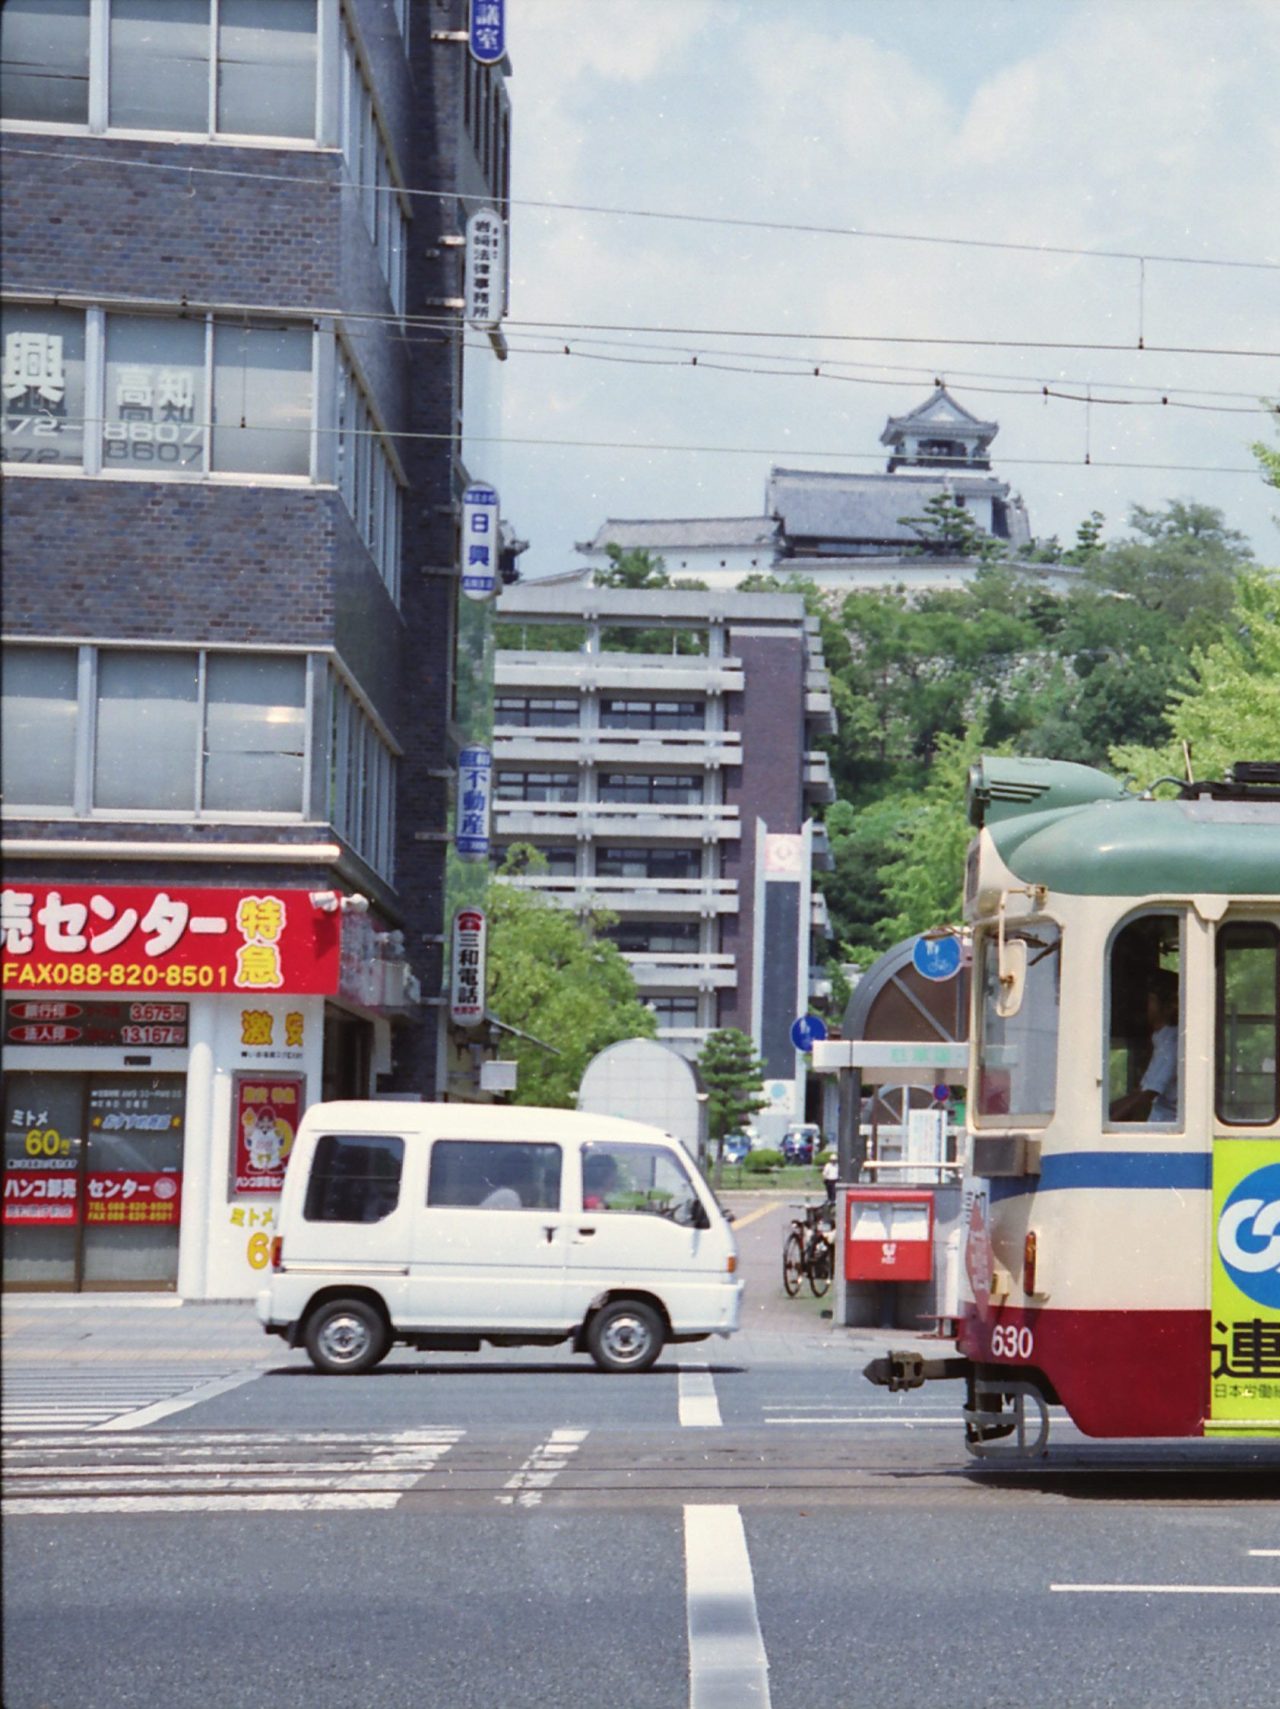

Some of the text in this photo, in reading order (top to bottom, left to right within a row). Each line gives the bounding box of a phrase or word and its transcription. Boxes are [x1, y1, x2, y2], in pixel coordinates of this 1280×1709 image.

[4, 331, 65, 403] 興
[117, 366, 194, 410] 高知
[3, 417, 204, 442] 72- 8607
[469, 513, 490, 566] 日興
[462, 769, 487, 836] 不動産
[2, 890, 228, 957] 売センター
[236, 895, 286, 988] 特急
[3, 962, 228, 986] FAX088-820-8501
[458, 932, 480, 1004] 三和電話
[88, 1177, 152, 1199] センター
[991, 1324, 1034, 1359] 630
